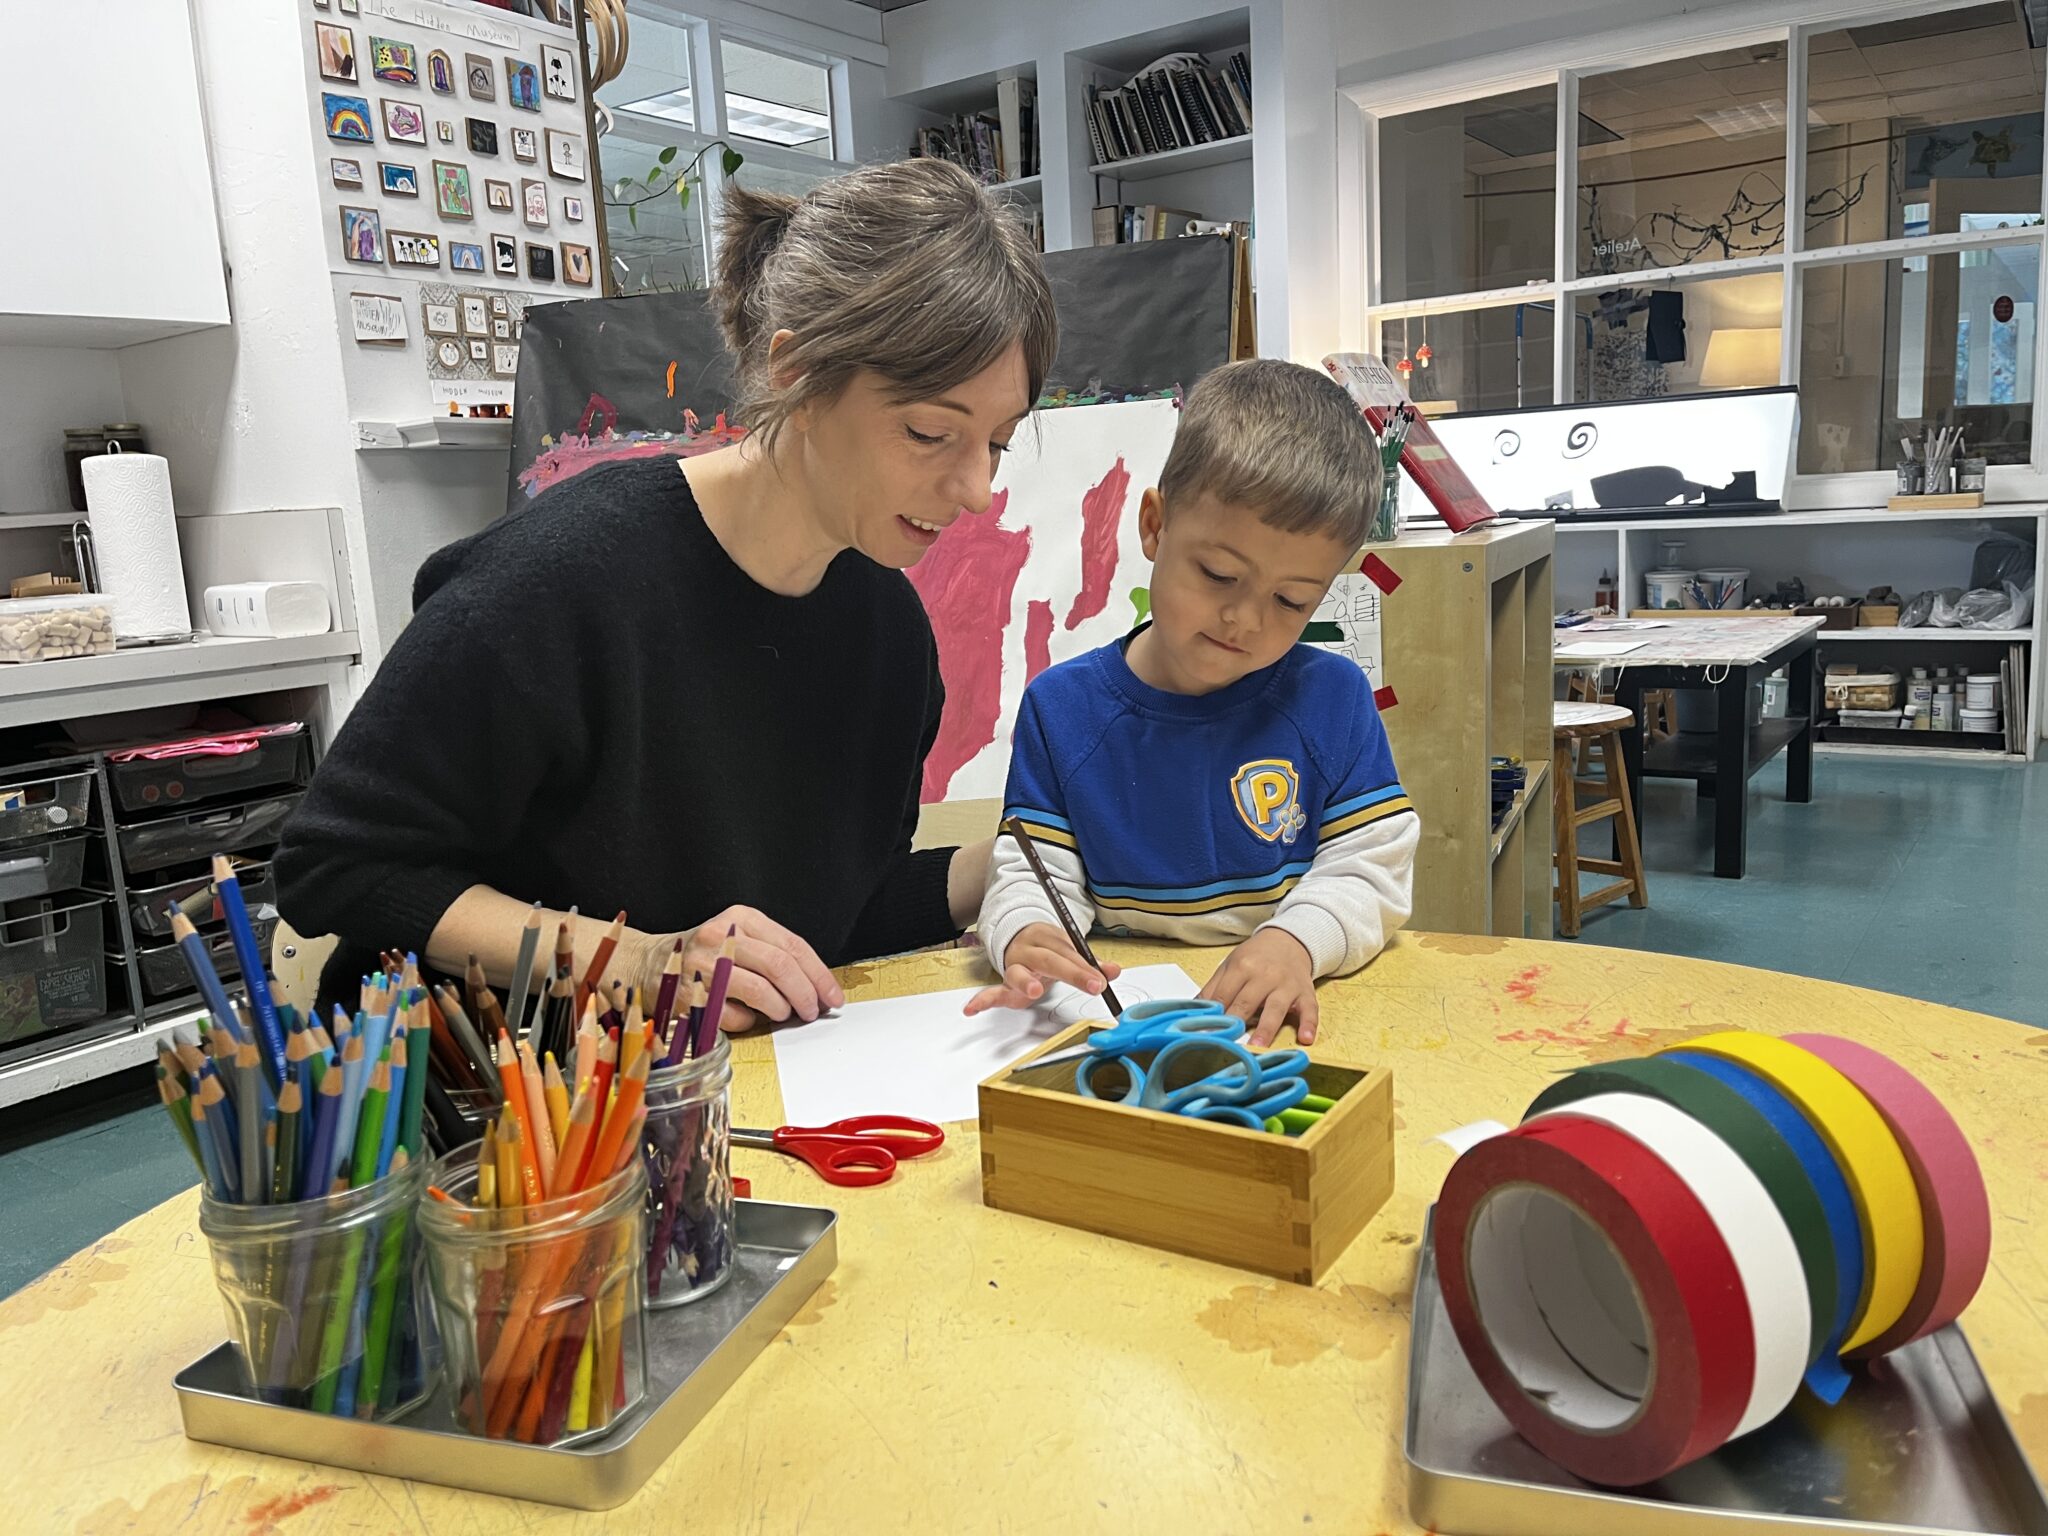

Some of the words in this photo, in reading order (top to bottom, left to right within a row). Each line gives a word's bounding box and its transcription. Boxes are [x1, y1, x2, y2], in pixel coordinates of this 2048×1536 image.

[414, 8, 450, 30] Hidden
[466, 23, 512, 41] Museum
[1347, 366, 1393, 384] ROTHKO
[1249, 771, 1288, 825] P
